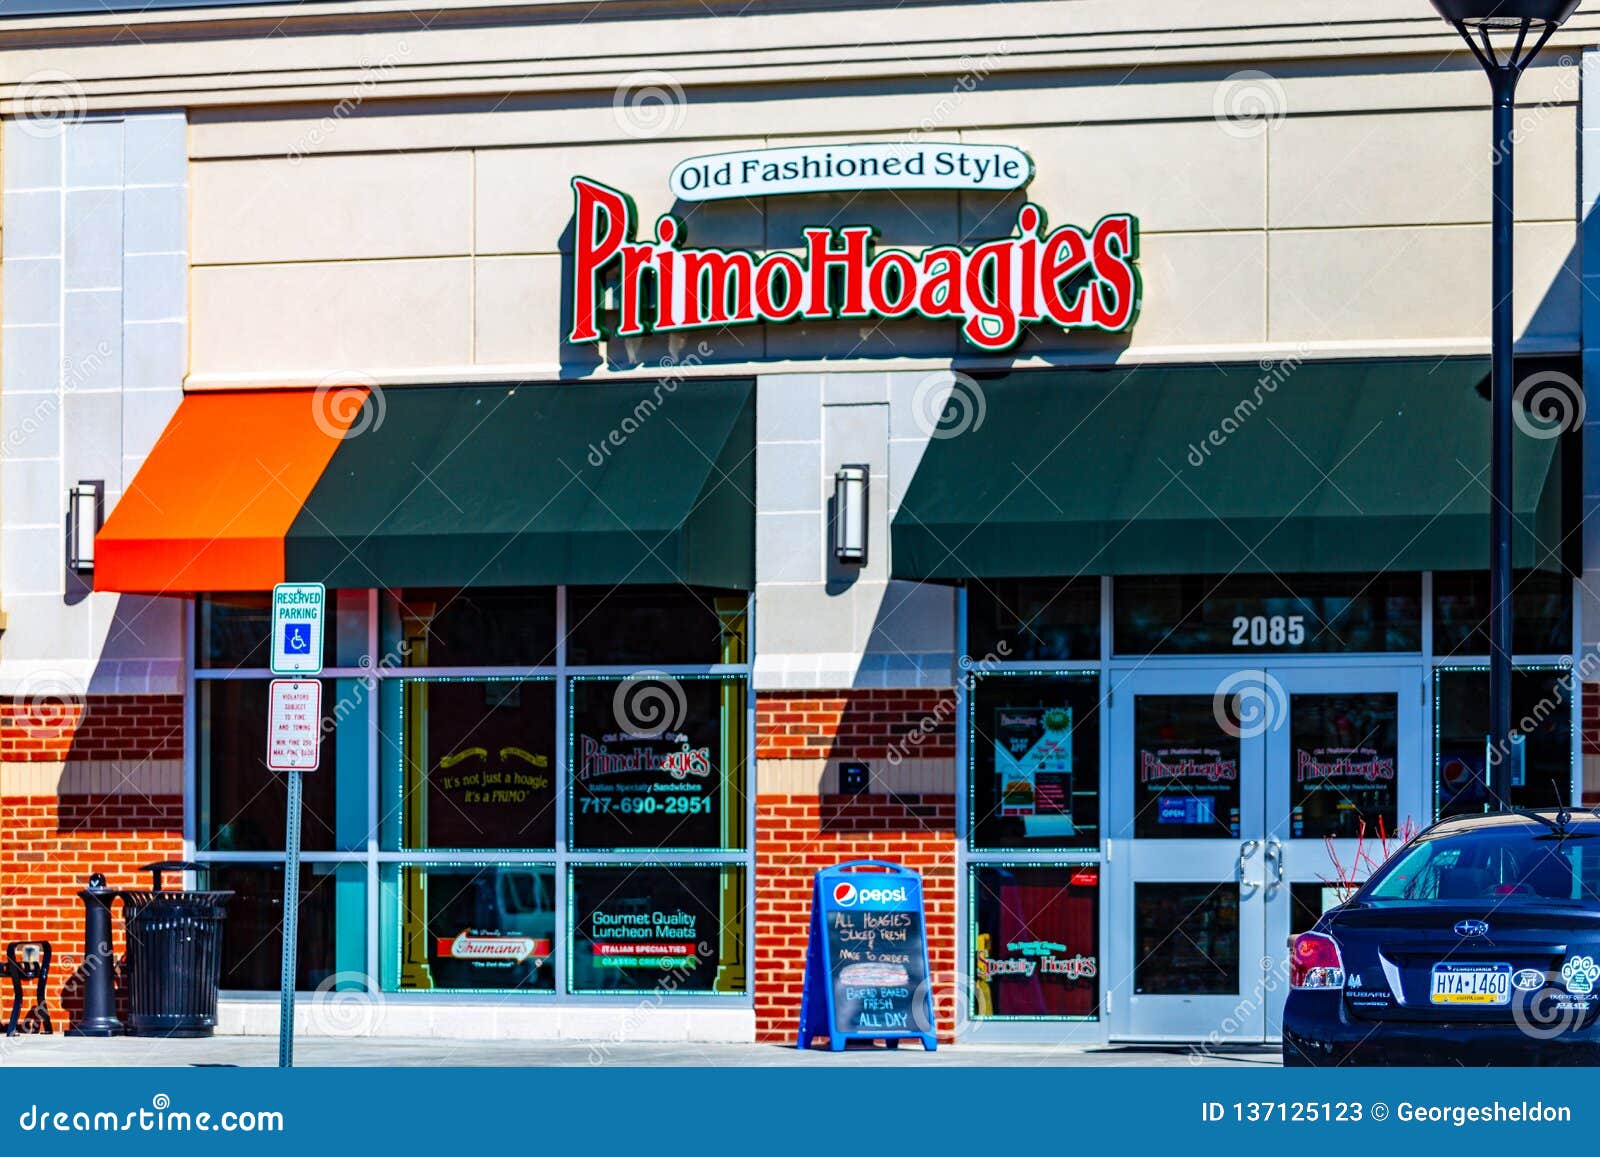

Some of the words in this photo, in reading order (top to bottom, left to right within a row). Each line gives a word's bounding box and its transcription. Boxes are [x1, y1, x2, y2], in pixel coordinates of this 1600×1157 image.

[680, 162, 732, 192] Old
[741, 153, 925, 185] Fashioned
[933, 151, 1021, 185] Style
[568, 176, 1136, 350] PrimoHoagies
[277, 592, 321, 604] RESERVED
[279, 607, 318, 619] PARKING
[1231, 615, 1305, 646] 2085
[580, 733, 710, 780] PrimoHoagies
[462, 773, 479, 786] not
[482, 770, 502, 787] just
[504, 773, 511, 783] a
[513, 771, 549, 789] hoagie
[482, 792, 490, 802] a
[580, 796, 711, 814] 717-690-2951
[860, 887, 908, 905] pepsi
[592, 911, 651, 925] Gourmet
[652, 909, 697, 928] Quality
[835, 911, 855, 928] ALL
[592, 925, 653, 938] Luncheon
[655, 925, 697, 938] Meats
[880, 928, 907, 942] FRESH
[601, 944, 634, 953] ITALIAN
[1519, 977, 1537, 987] Art
[863, 998, 894, 1010] FRESH
[860, 1012, 882, 1028] ALL
[884, 1011, 908, 1028] DAY
